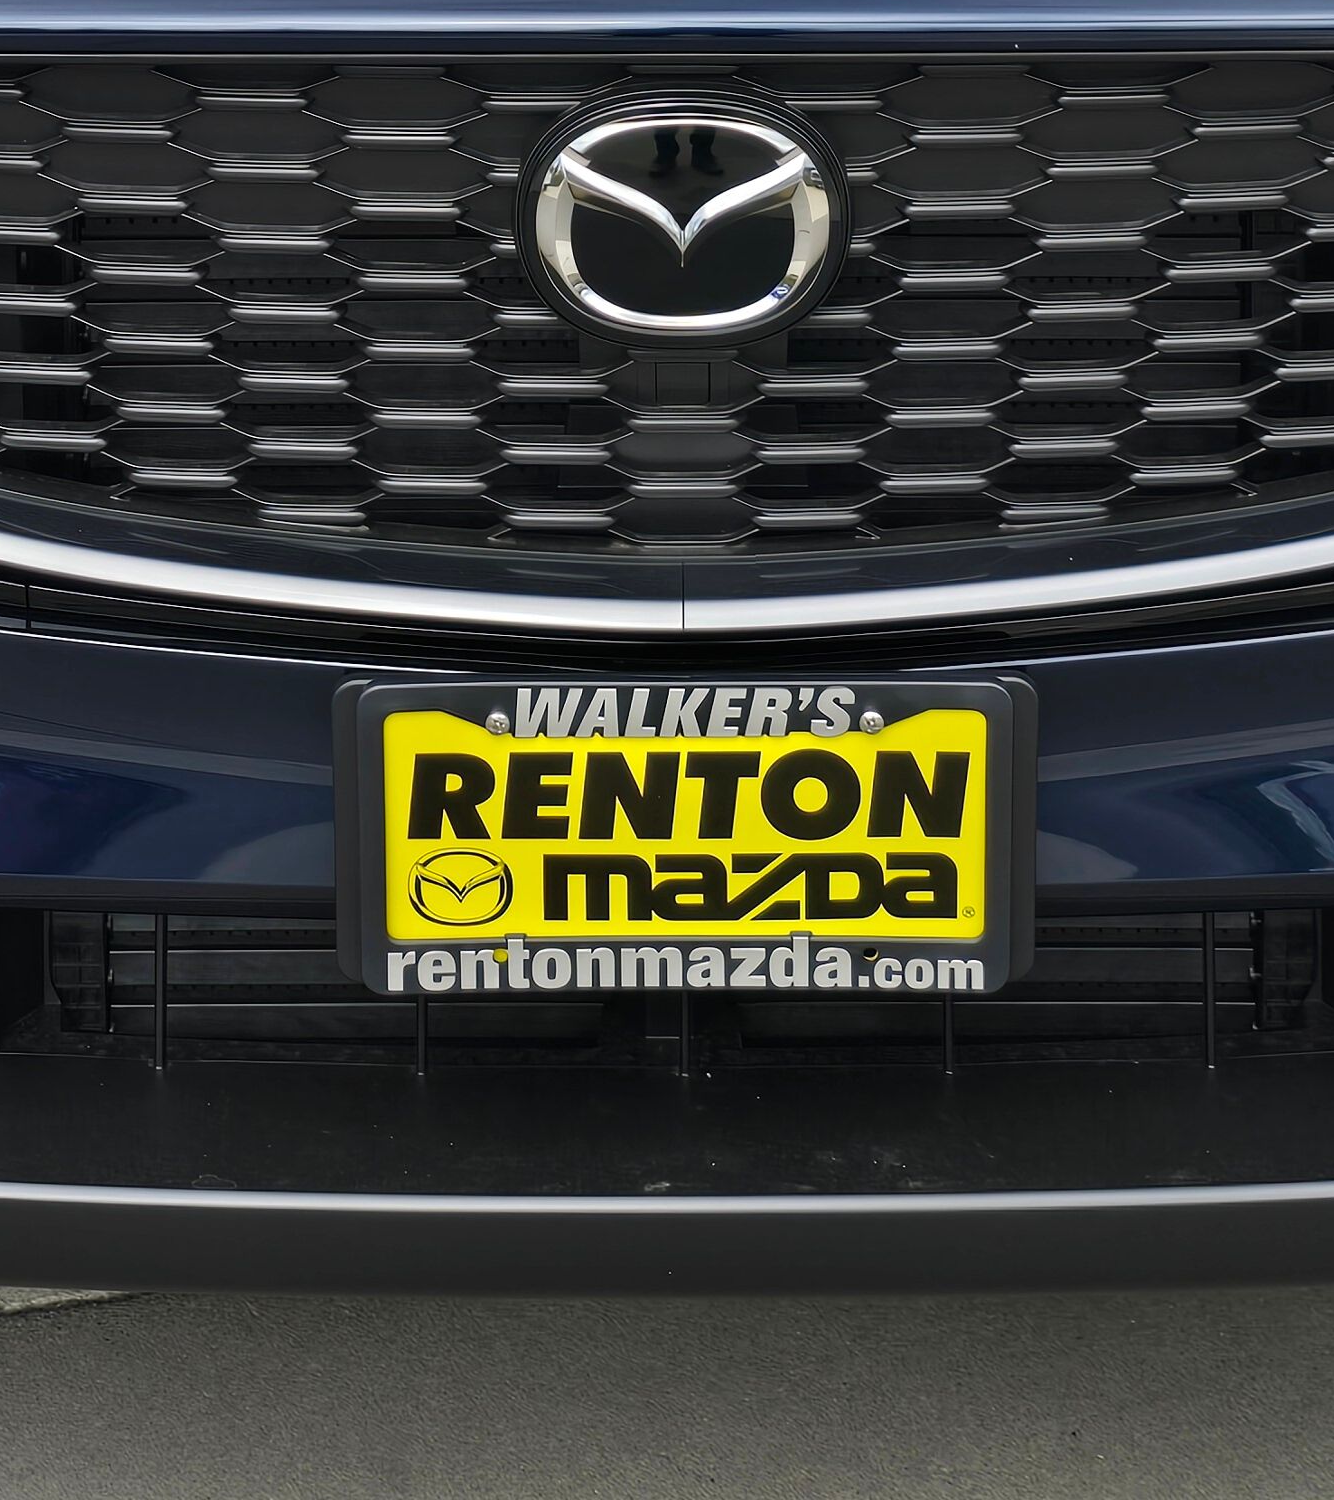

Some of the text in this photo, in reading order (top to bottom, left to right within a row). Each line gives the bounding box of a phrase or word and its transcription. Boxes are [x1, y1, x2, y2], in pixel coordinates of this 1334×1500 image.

[510, 686, 856, 739] WALKER'S
[407, 748, 970, 841] RENTON
[386, 934, 985, 992] rentonmazda.com
